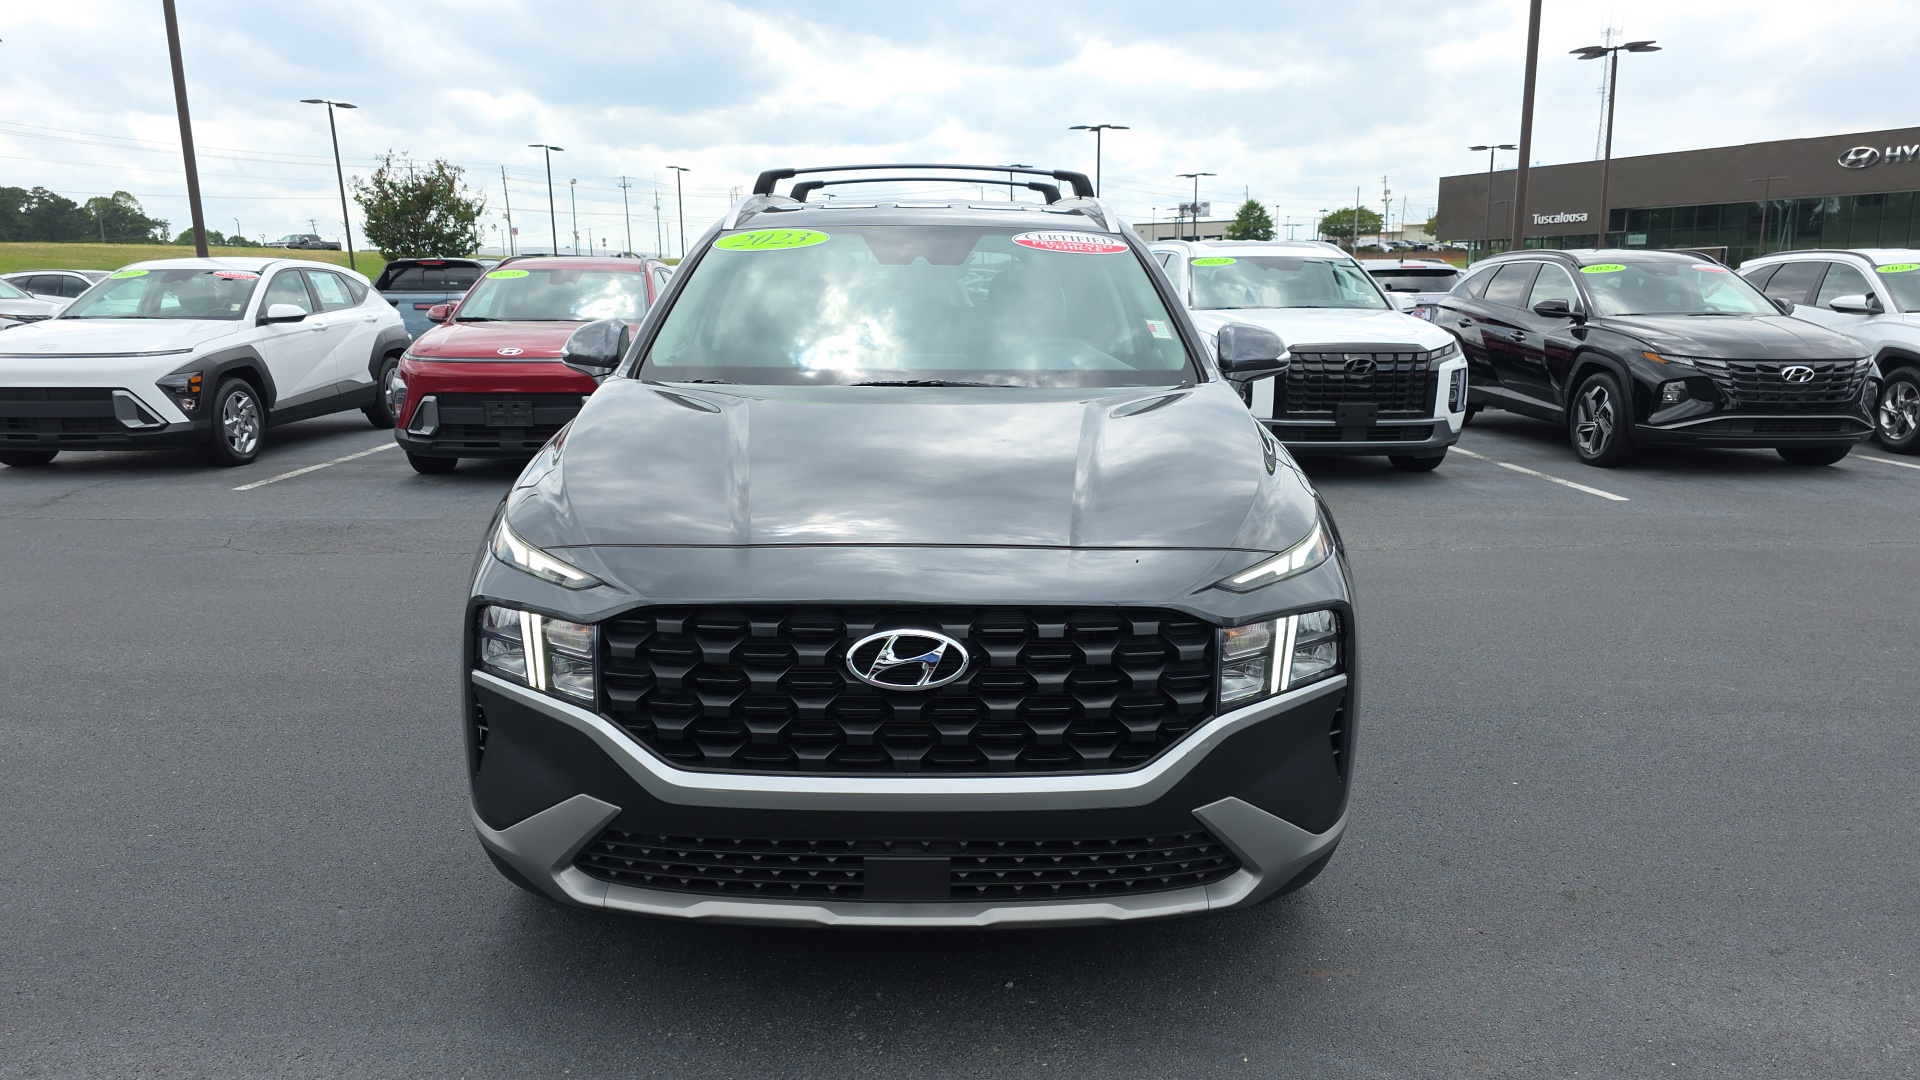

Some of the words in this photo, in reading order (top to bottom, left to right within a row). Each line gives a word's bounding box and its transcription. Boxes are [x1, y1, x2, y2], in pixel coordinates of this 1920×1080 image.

[1885, 144, 1920, 163] HY
[1532, 212, 1588, 225] Tuscaloosa
[731, 232, 813, 248] 2023
[1024, 233, 1115, 245] CERTIFIED
[1045, 243, 1104, 253] VEHICLE
[1588, 264, 1619, 273] 2024
